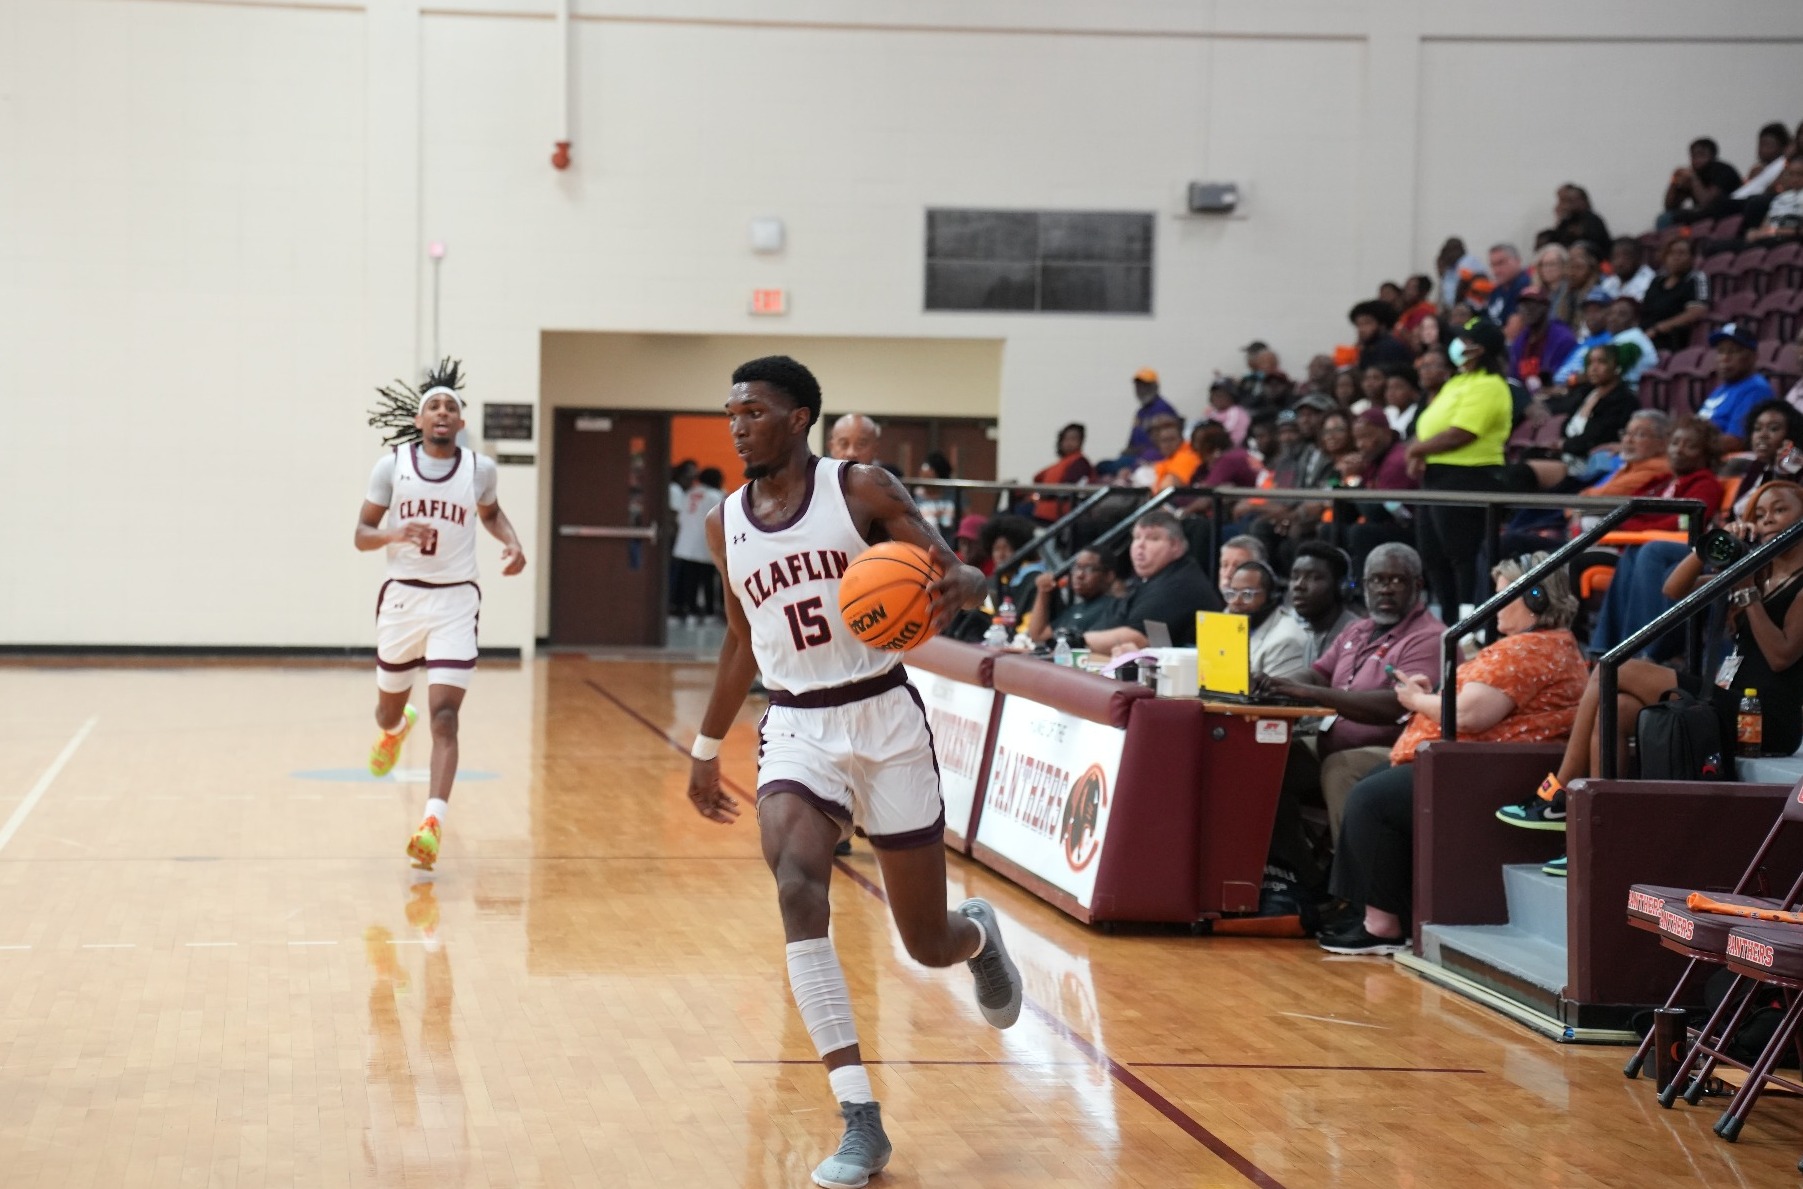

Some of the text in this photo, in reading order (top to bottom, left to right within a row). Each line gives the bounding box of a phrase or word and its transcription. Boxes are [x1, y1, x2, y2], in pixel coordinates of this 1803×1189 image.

[399, 499, 468, 527] CLAFLIN
[744, 550, 850, 609] CLAFLIN
[783, 596, 833, 652] 15
[988, 745, 1070, 839] PANTHERS
[1726, 933, 1774, 967] PANTHERS
